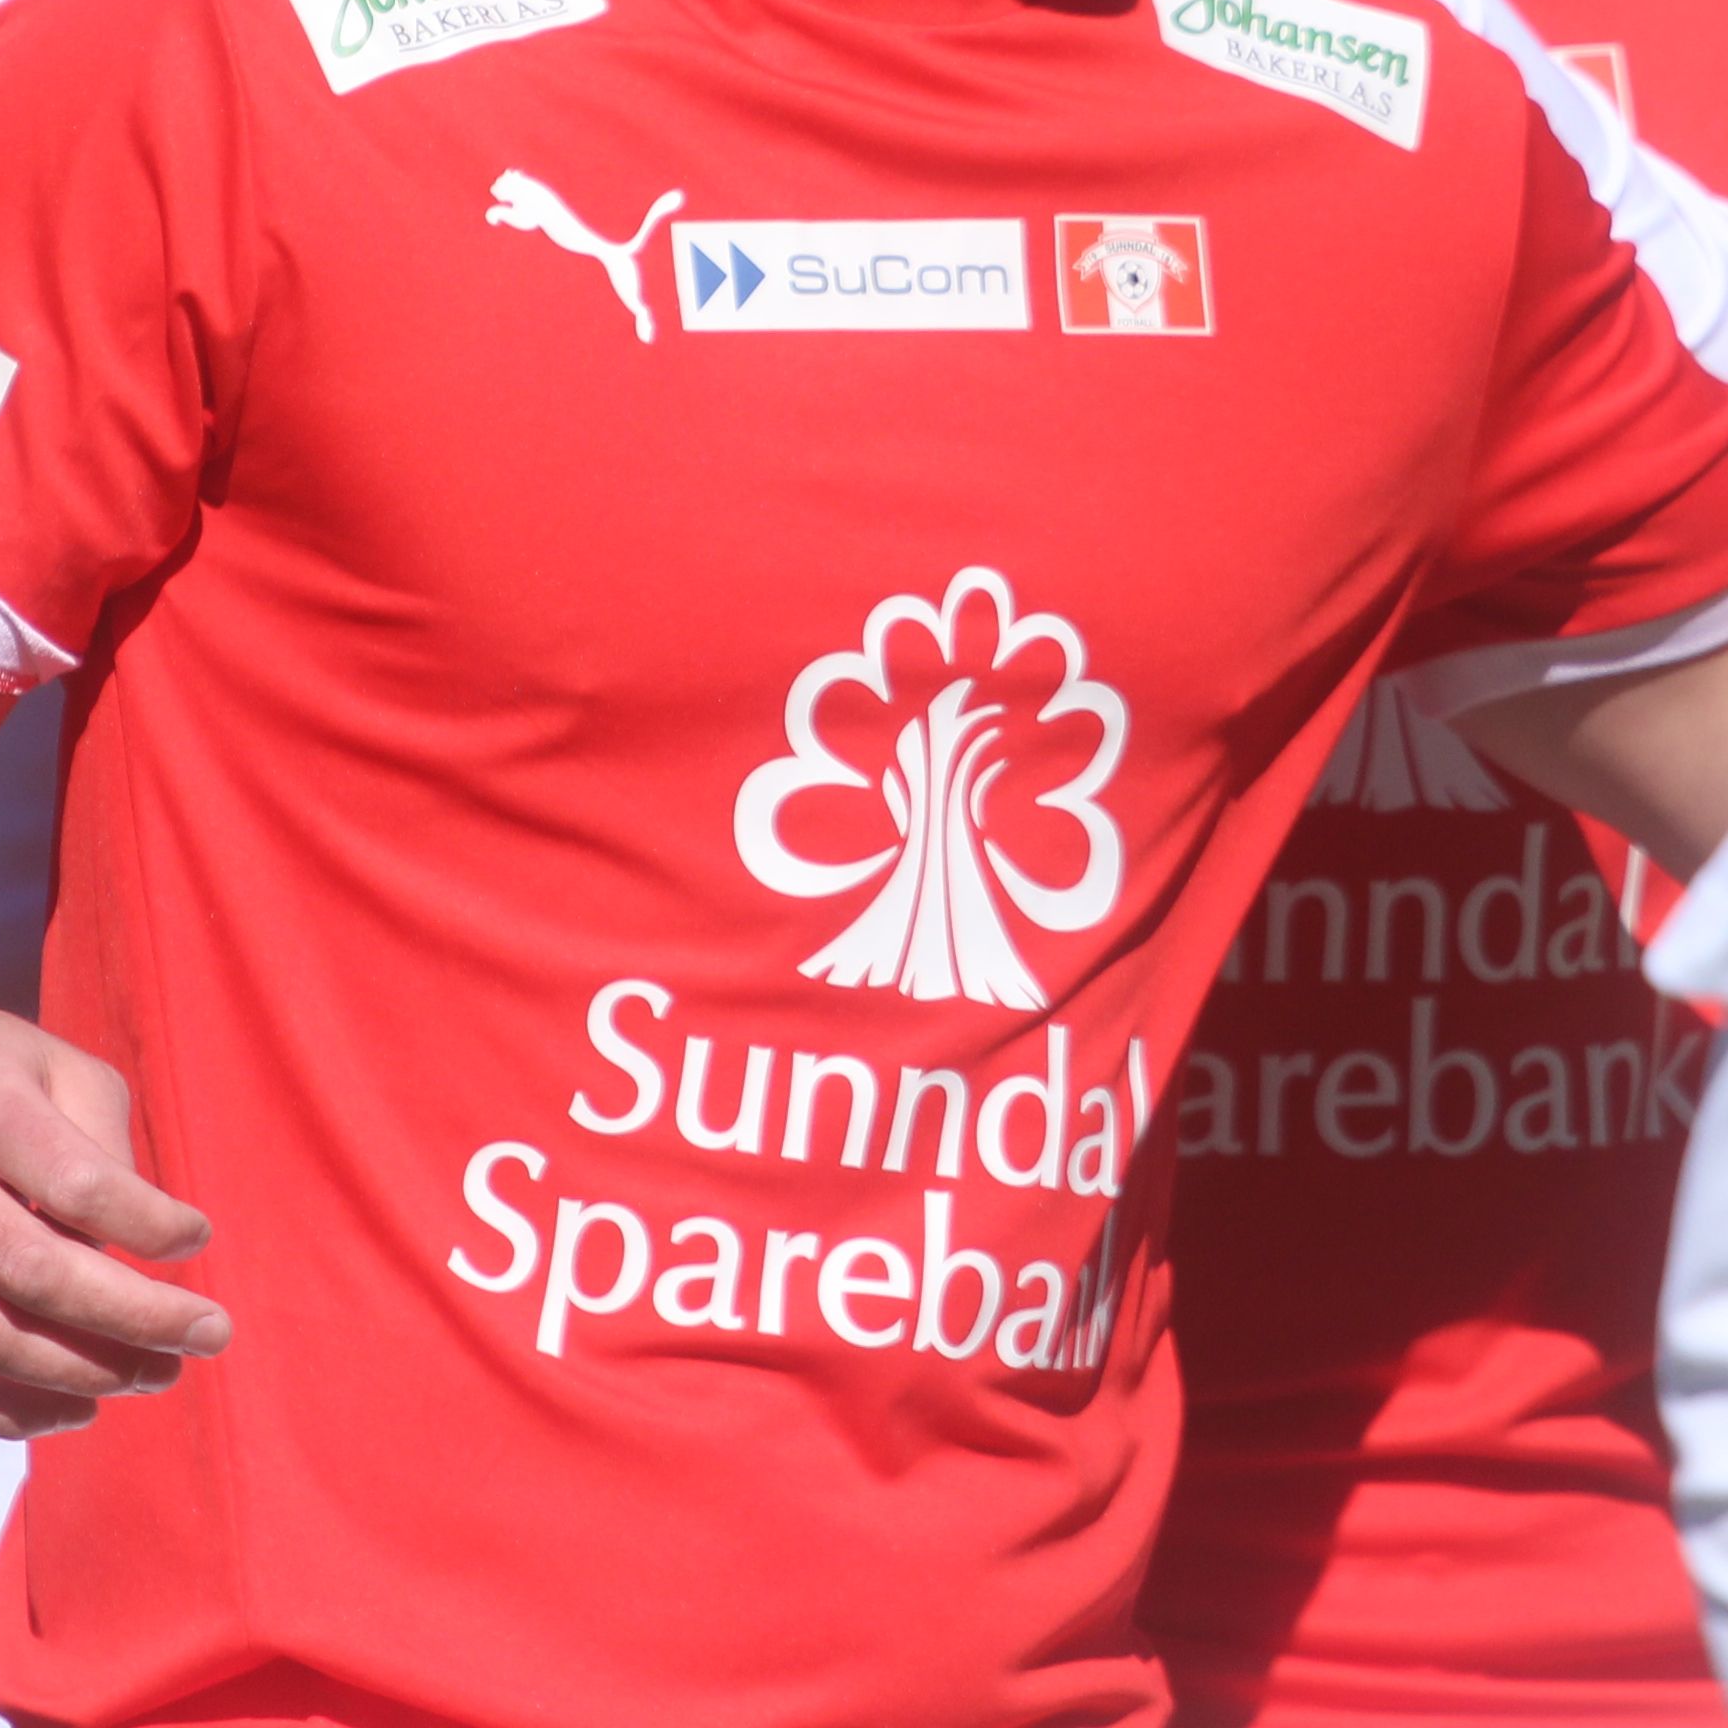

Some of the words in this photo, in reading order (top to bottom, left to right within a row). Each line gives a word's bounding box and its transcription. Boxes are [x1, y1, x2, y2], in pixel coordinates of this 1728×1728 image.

[390, 4, 506, 48] BAKERI
[1227, 37, 1341, 93] BAKERI
[788, 255, 1009, 296] SuCom
[1217, 822, 1649, 983] nndal
[568, 978, 1153, 1199] Sunndal
[1177, 994, 1702, 1158] arebank
